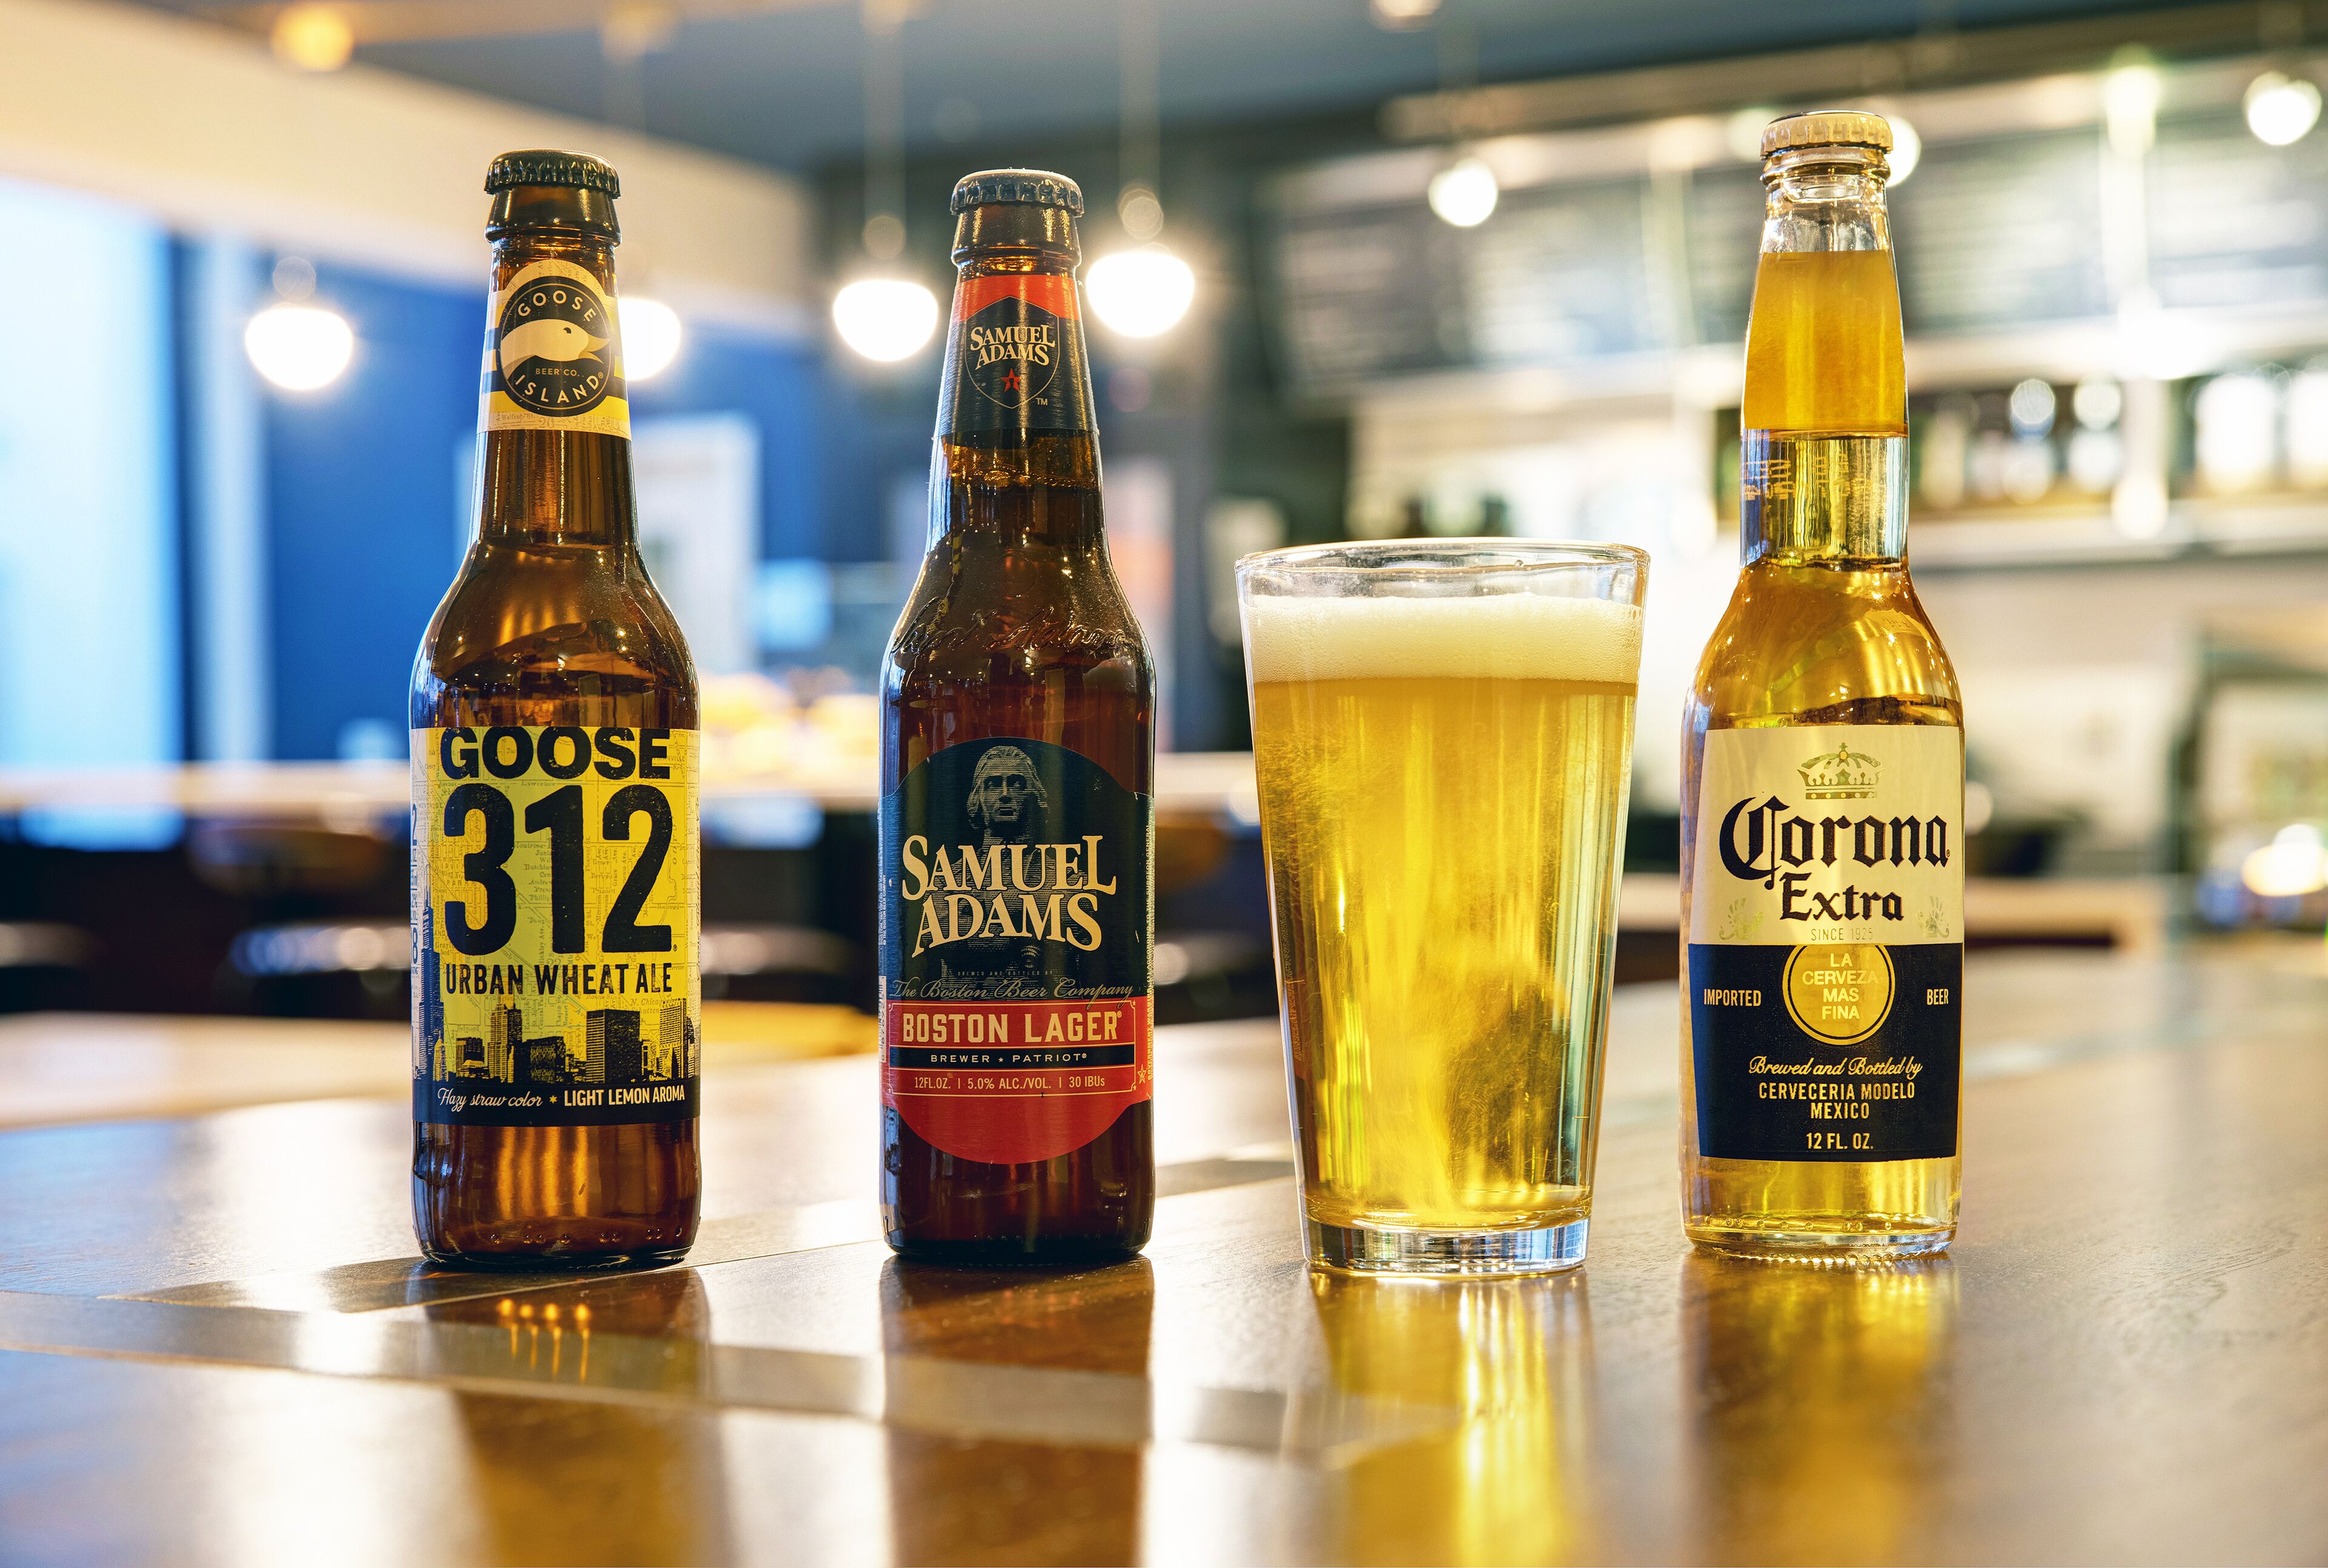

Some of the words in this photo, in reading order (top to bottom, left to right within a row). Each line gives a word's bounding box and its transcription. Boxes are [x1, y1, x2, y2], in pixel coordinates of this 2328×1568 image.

[518, 290, 597, 323] GOOSE
[970, 324, 1055, 352] SAMUEL
[975, 343, 1049, 370] ADAMS
[535, 367, 560, 376] BEER
[441, 726, 671, 780] GOOSE
[902, 835, 1117, 901] SAMUEL
[1779, 872, 1904, 921] Extra
[911, 893, 1102, 958] ADAMS
[1811, 928, 1844, 941] SINCE
[1850, 927, 1874, 940] 1925
[1830, 953, 1853, 967] LA
[446, 964, 524, 995] URBAN
[535, 964, 629, 995] WHEAT
[635, 962, 672, 993] ALE
[1802, 970, 1878, 986] CERVEZA
[890, 977, 917, 998] The
[921, 976, 988, 998] Boston
[994, 977, 1048, 998] Beer
[1054, 977, 1133, 1010] Company
[1704, 989, 1762, 1007] IMPORTED
[1823, 988, 1859, 1003] MAS
[1927, 989, 1949, 1006] BEER
[1822, 1006, 1860, 1020] FINA
[903, 1013, 1008, 1043] BOSTON
[931, 1054, 990, 1063] BREWER
[1748, 1056, 1811, 1075] Brewed
[1813, 1058, 1844, 1075] and
[1848, 1056, 1905, 1075] Bottled
[1905, 1056, 1922, 1079] by
[968, 1078, 994, 1089] 5.0%
[999, 1076, 1051, 1089] ALC./VOL.
[1069, 1076, 1082, 1089] 30
[1084, 1076, 1105, 1088] IBUs
[1759, 1083, 1855, 1100] CERVECERIA
[1860, 1082, 1915, 1099] MODELO
[437, 1088, 467, 1112] Hazy
[470, 1090, 507, 1107] straw
[508, 1089, 543, 1107] color
[564, 1089, 604, 1107] LIGHT
[609, 1087, 650, 1106] LEMON
[652, 1084, 685, 1104] AROMA
[1810, 1103, 1870, 1119] MEXICO
[1806, 1133, 1823, 1150] 12
[1827, 1133, 1847, 1149] FL.
[1852, 1133, 1874, 1149] OZ.
